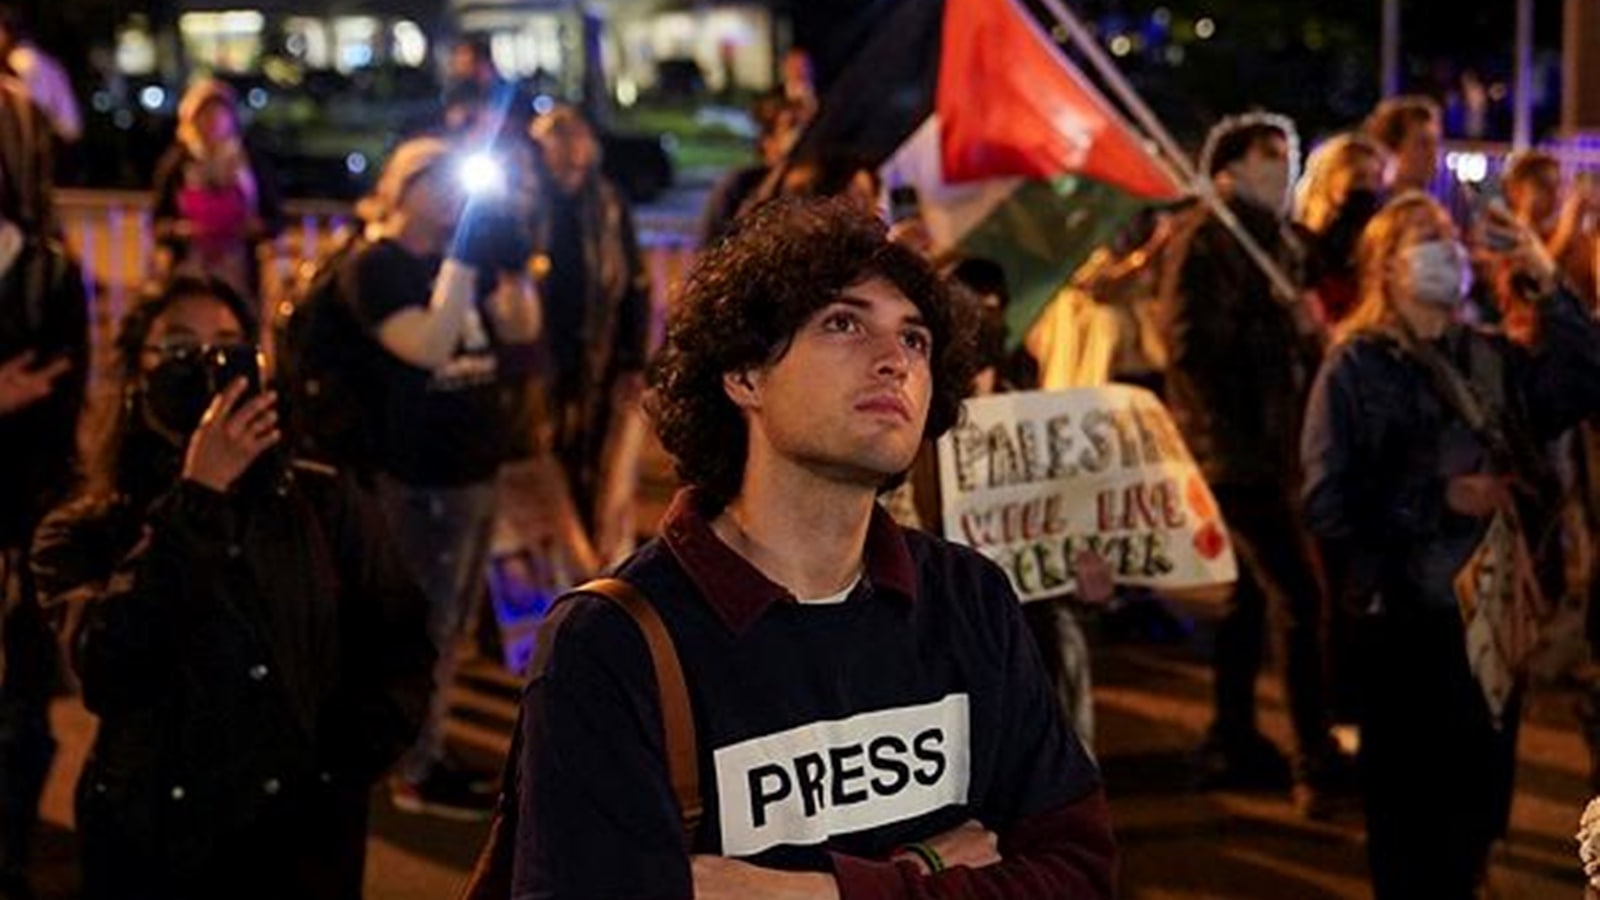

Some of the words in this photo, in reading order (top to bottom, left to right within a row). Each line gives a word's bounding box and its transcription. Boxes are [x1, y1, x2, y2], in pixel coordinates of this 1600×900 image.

[961, 494, 1067, 548] WILL
[1097, 477, 1186, 532] LIVE
[747, 728, 946, 828] PRESS
